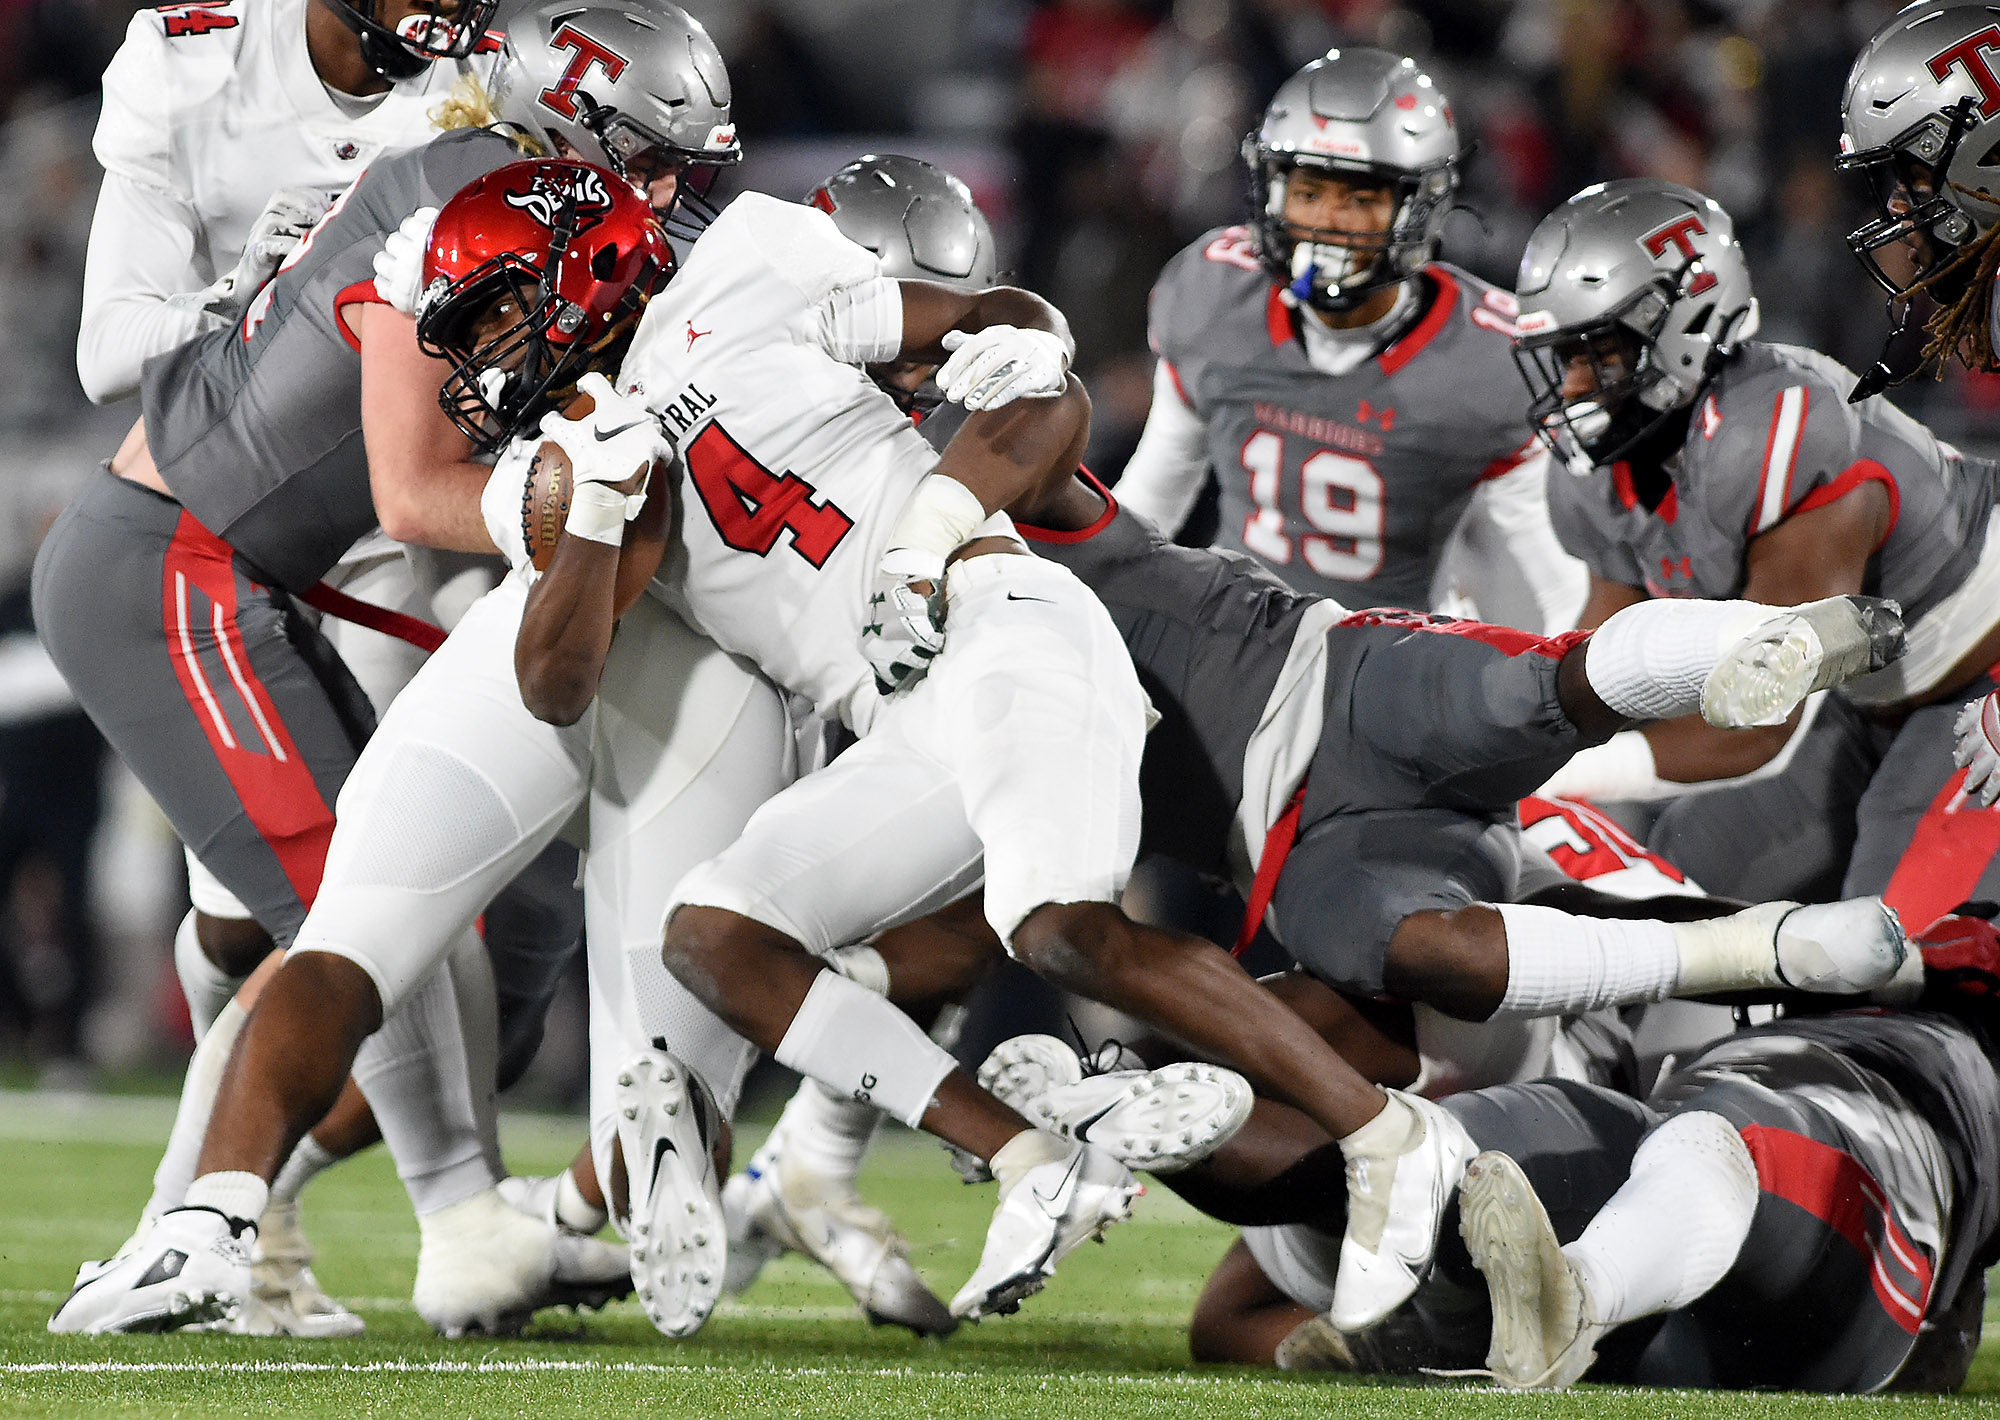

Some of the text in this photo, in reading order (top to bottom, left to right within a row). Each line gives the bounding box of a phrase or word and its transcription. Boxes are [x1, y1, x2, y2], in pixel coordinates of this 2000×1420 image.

[537, 23, 632, 123] T
[1923, 23, 2000, 123] T
[1636, 211, 1719, 298] T
[684, 417, 856, 571] 4
[1239, 428, 1388, 582] 19
